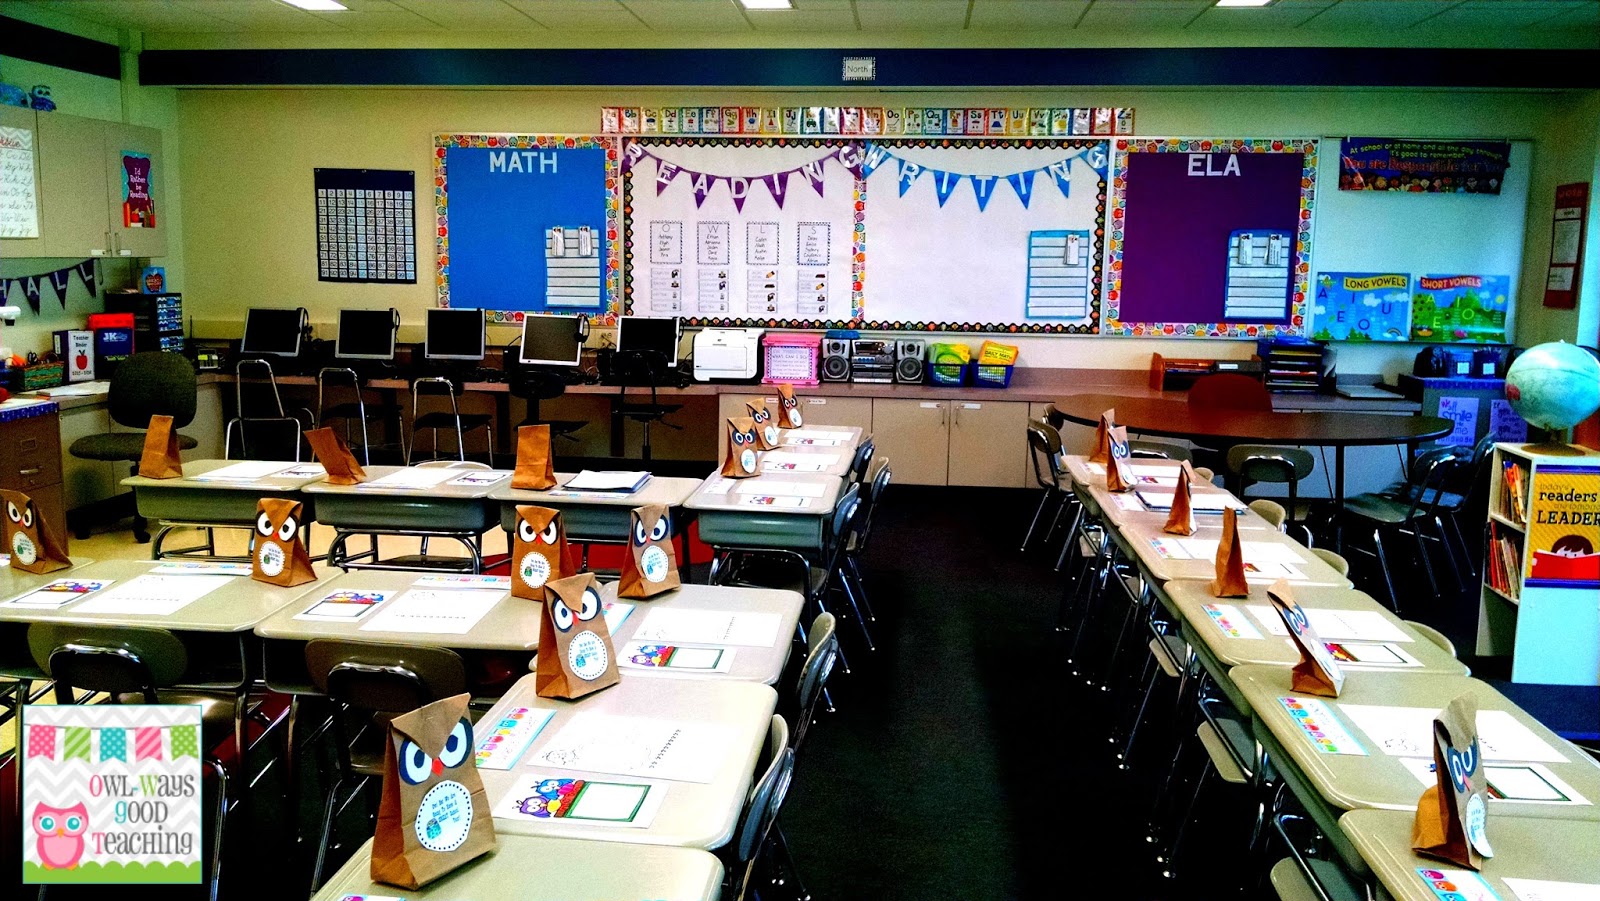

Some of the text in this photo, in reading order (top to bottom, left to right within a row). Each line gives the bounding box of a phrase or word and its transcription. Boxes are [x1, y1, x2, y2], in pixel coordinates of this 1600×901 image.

[1360, 144, 1382, 152] school
[489, 151, 558, 173] MATH
[1187, 153, 1241, 176] ELA
[1369, 159, 1387, 169] are
[628, 146, 857, 198] READING
[864, 143, 1107, 198] WRITING
[130, 175, 146, 183] Rather
[130, 190, 148, 200] Reading
[662, 224, 670, 232] O
[708, 225, 719, 233] W
[812, 226, 816, 234] S
[1345, 276, 1406, 289] LONG VOWELS
[1421, 277, 1482, 288] SHORT VOWELS
[1318, 288, 1328, 298] A
[1382, 304, 1391, 314] U
[1462, 308, 1474, 320] O
[1337, 311, 1345, 322] E
[1433, 316, 1441, 328] E
[1358, 319, 1370, 330] O
[1539, 488, 1597, 502] readers
